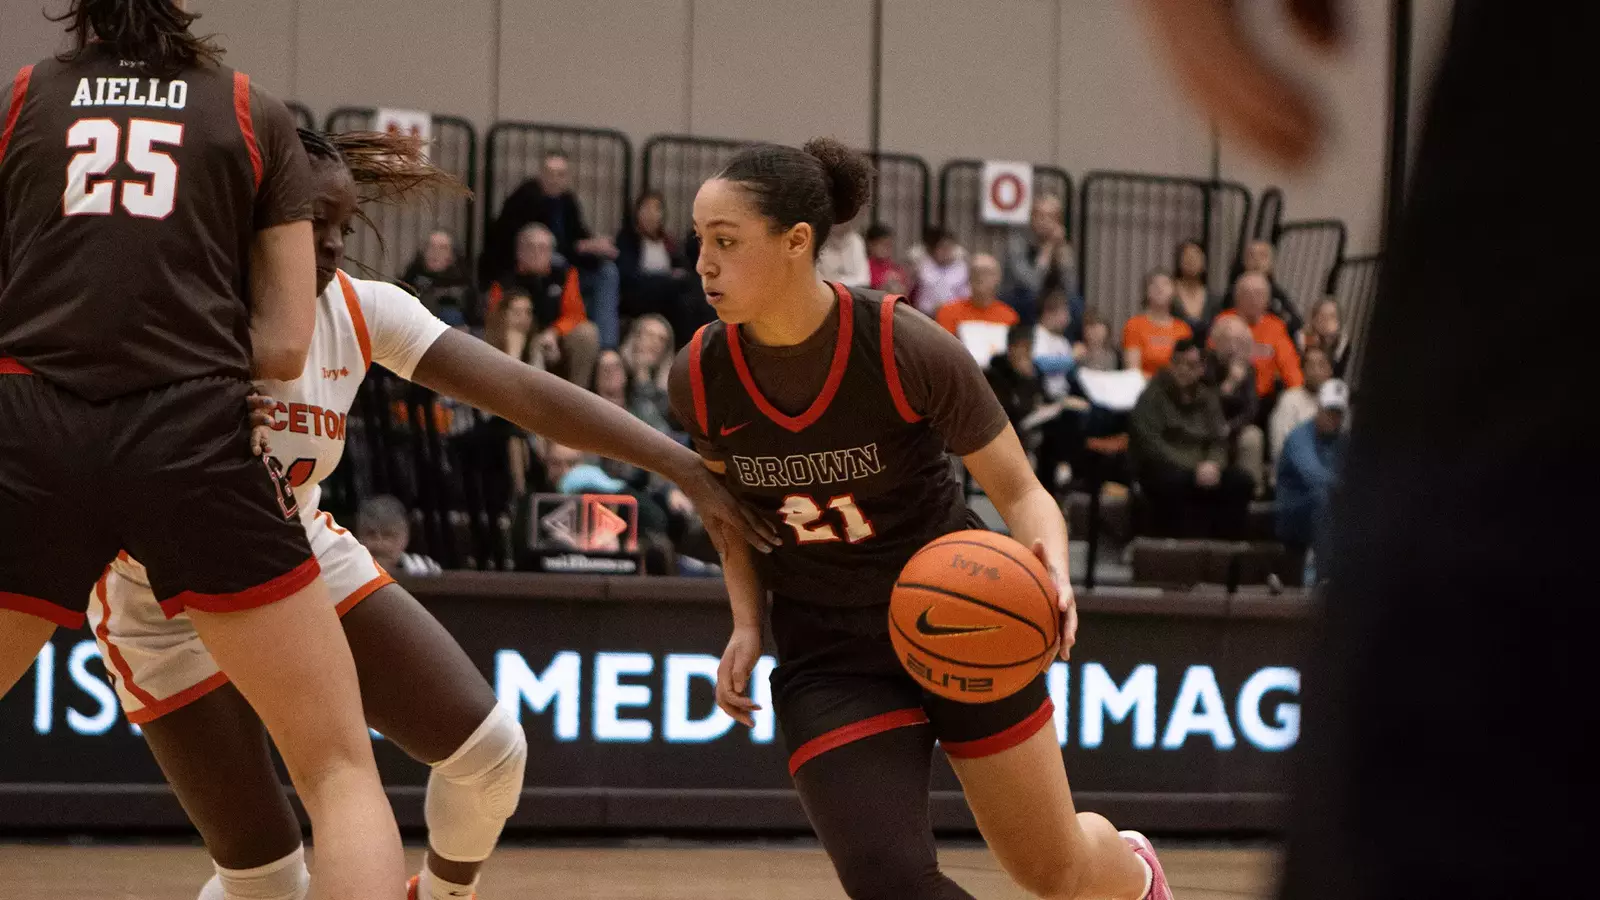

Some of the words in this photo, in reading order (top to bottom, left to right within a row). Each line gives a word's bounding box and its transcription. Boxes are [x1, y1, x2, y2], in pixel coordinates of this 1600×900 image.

[71, 77, 188, 109] AIELLO
[63, 117, 185, 220] 25
[269, 401, 347, 440] CETON
[733, 443, 881, 487] BROWN
[776, 492, 876, 545] 21
[34, 640, 120, 736] IS
[494, 648, 778, 744] MEDI
[1045, 660, 1301, 752] IMAG
